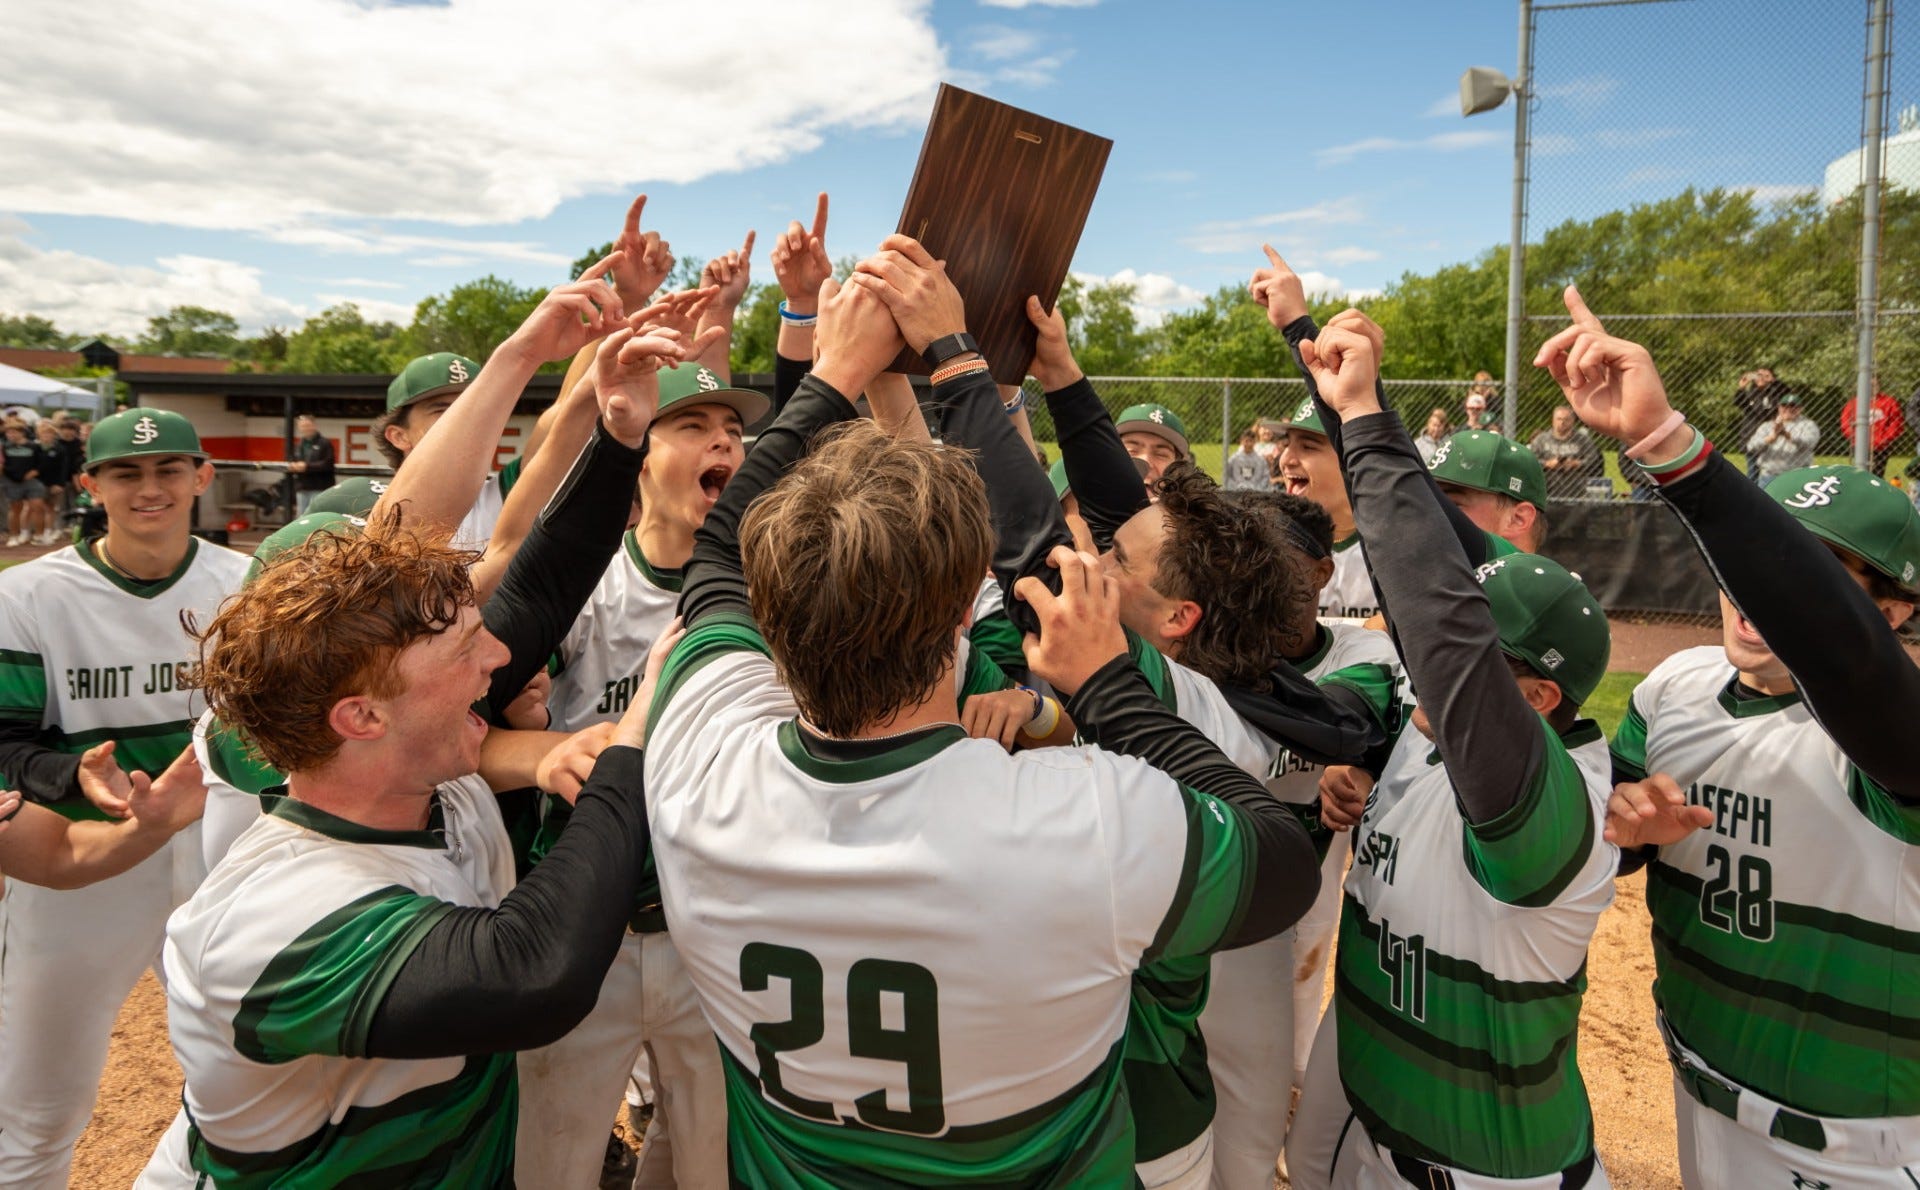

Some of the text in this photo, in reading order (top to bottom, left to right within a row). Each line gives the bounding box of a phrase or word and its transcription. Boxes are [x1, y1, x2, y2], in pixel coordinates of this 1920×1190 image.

[66, 661, 201, 700] SAINT JOS
[597, 673, 645, 714] SAI
[1684, 782, 1773, 847] SEPH
[1699, 843, 1775, 943] 28
[1379, 917, 1426, 1023] 41
[739, 941, 950, 1139] 29
